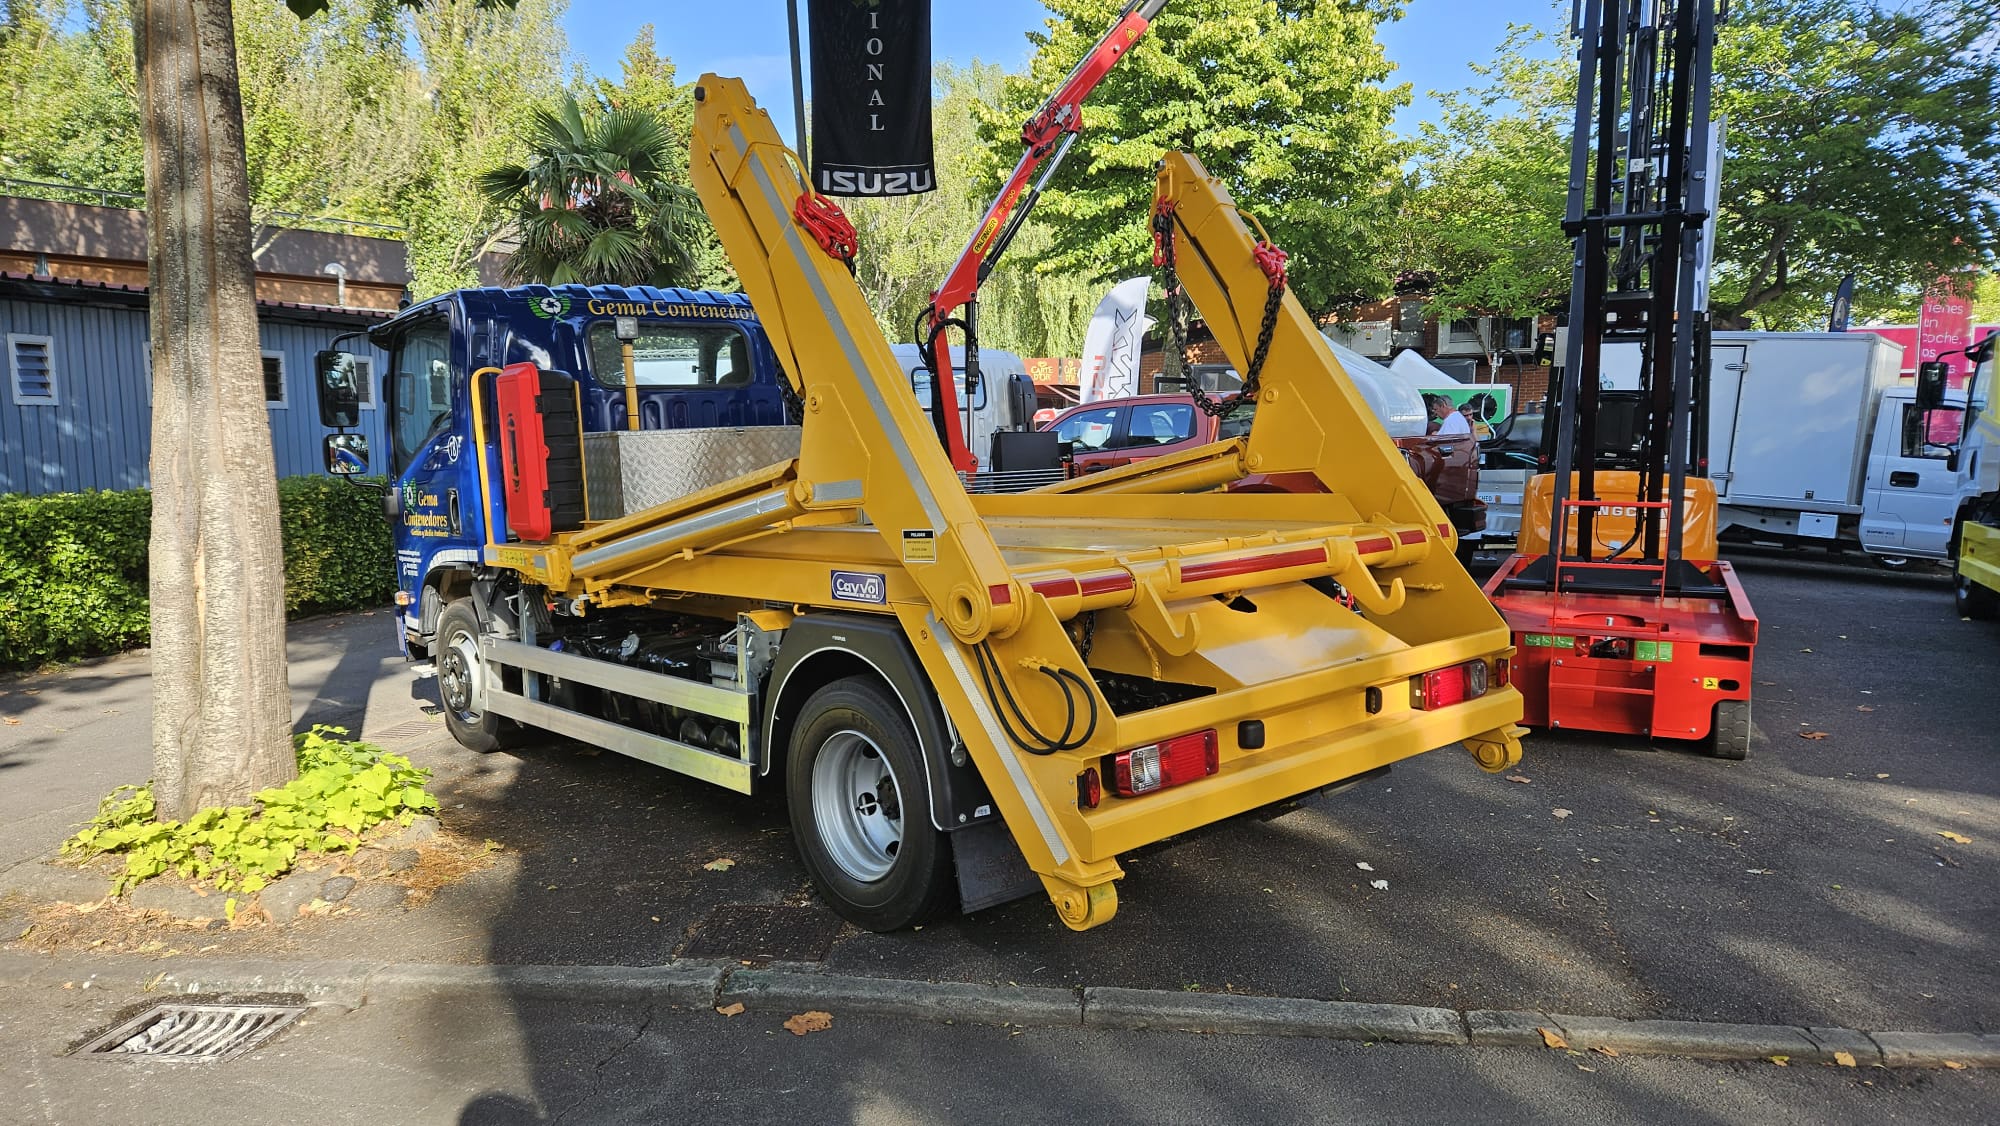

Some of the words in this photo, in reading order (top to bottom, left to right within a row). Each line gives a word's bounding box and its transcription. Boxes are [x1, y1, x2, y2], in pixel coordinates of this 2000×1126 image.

[822, 168, 931, 194] ISUZU
[974, 219, 997, 251] PALFINGER
[587, 299, 648, 316] Gema
[417, 490, 438, 507] Gema
[403, 509, 448, 527] Contenedores
